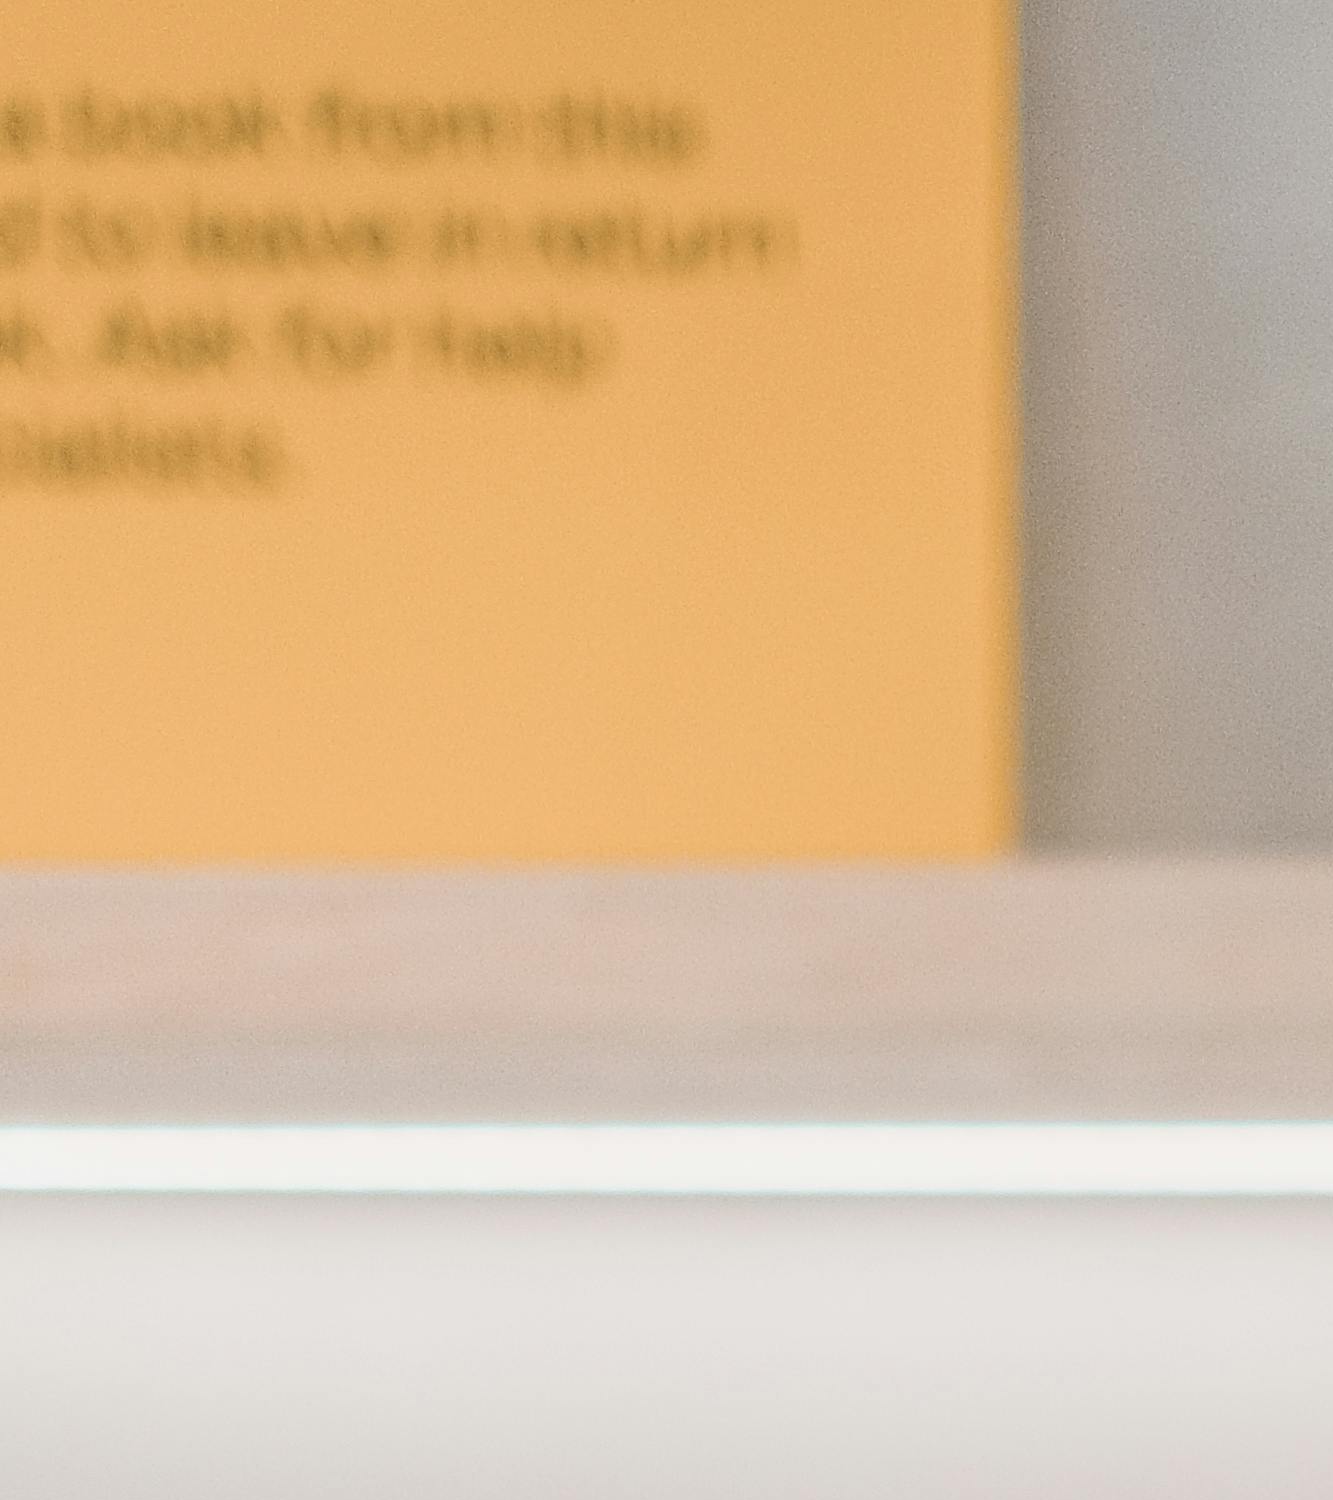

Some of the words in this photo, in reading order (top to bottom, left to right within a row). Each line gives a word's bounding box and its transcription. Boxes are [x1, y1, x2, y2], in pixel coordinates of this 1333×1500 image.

[65, 86, 275, 158] book
[308, 86, 515, 160] from
[535, 90, 698, 162] this
[180, 203, 402, 268] leave
[532, 208, 790, 275] return
